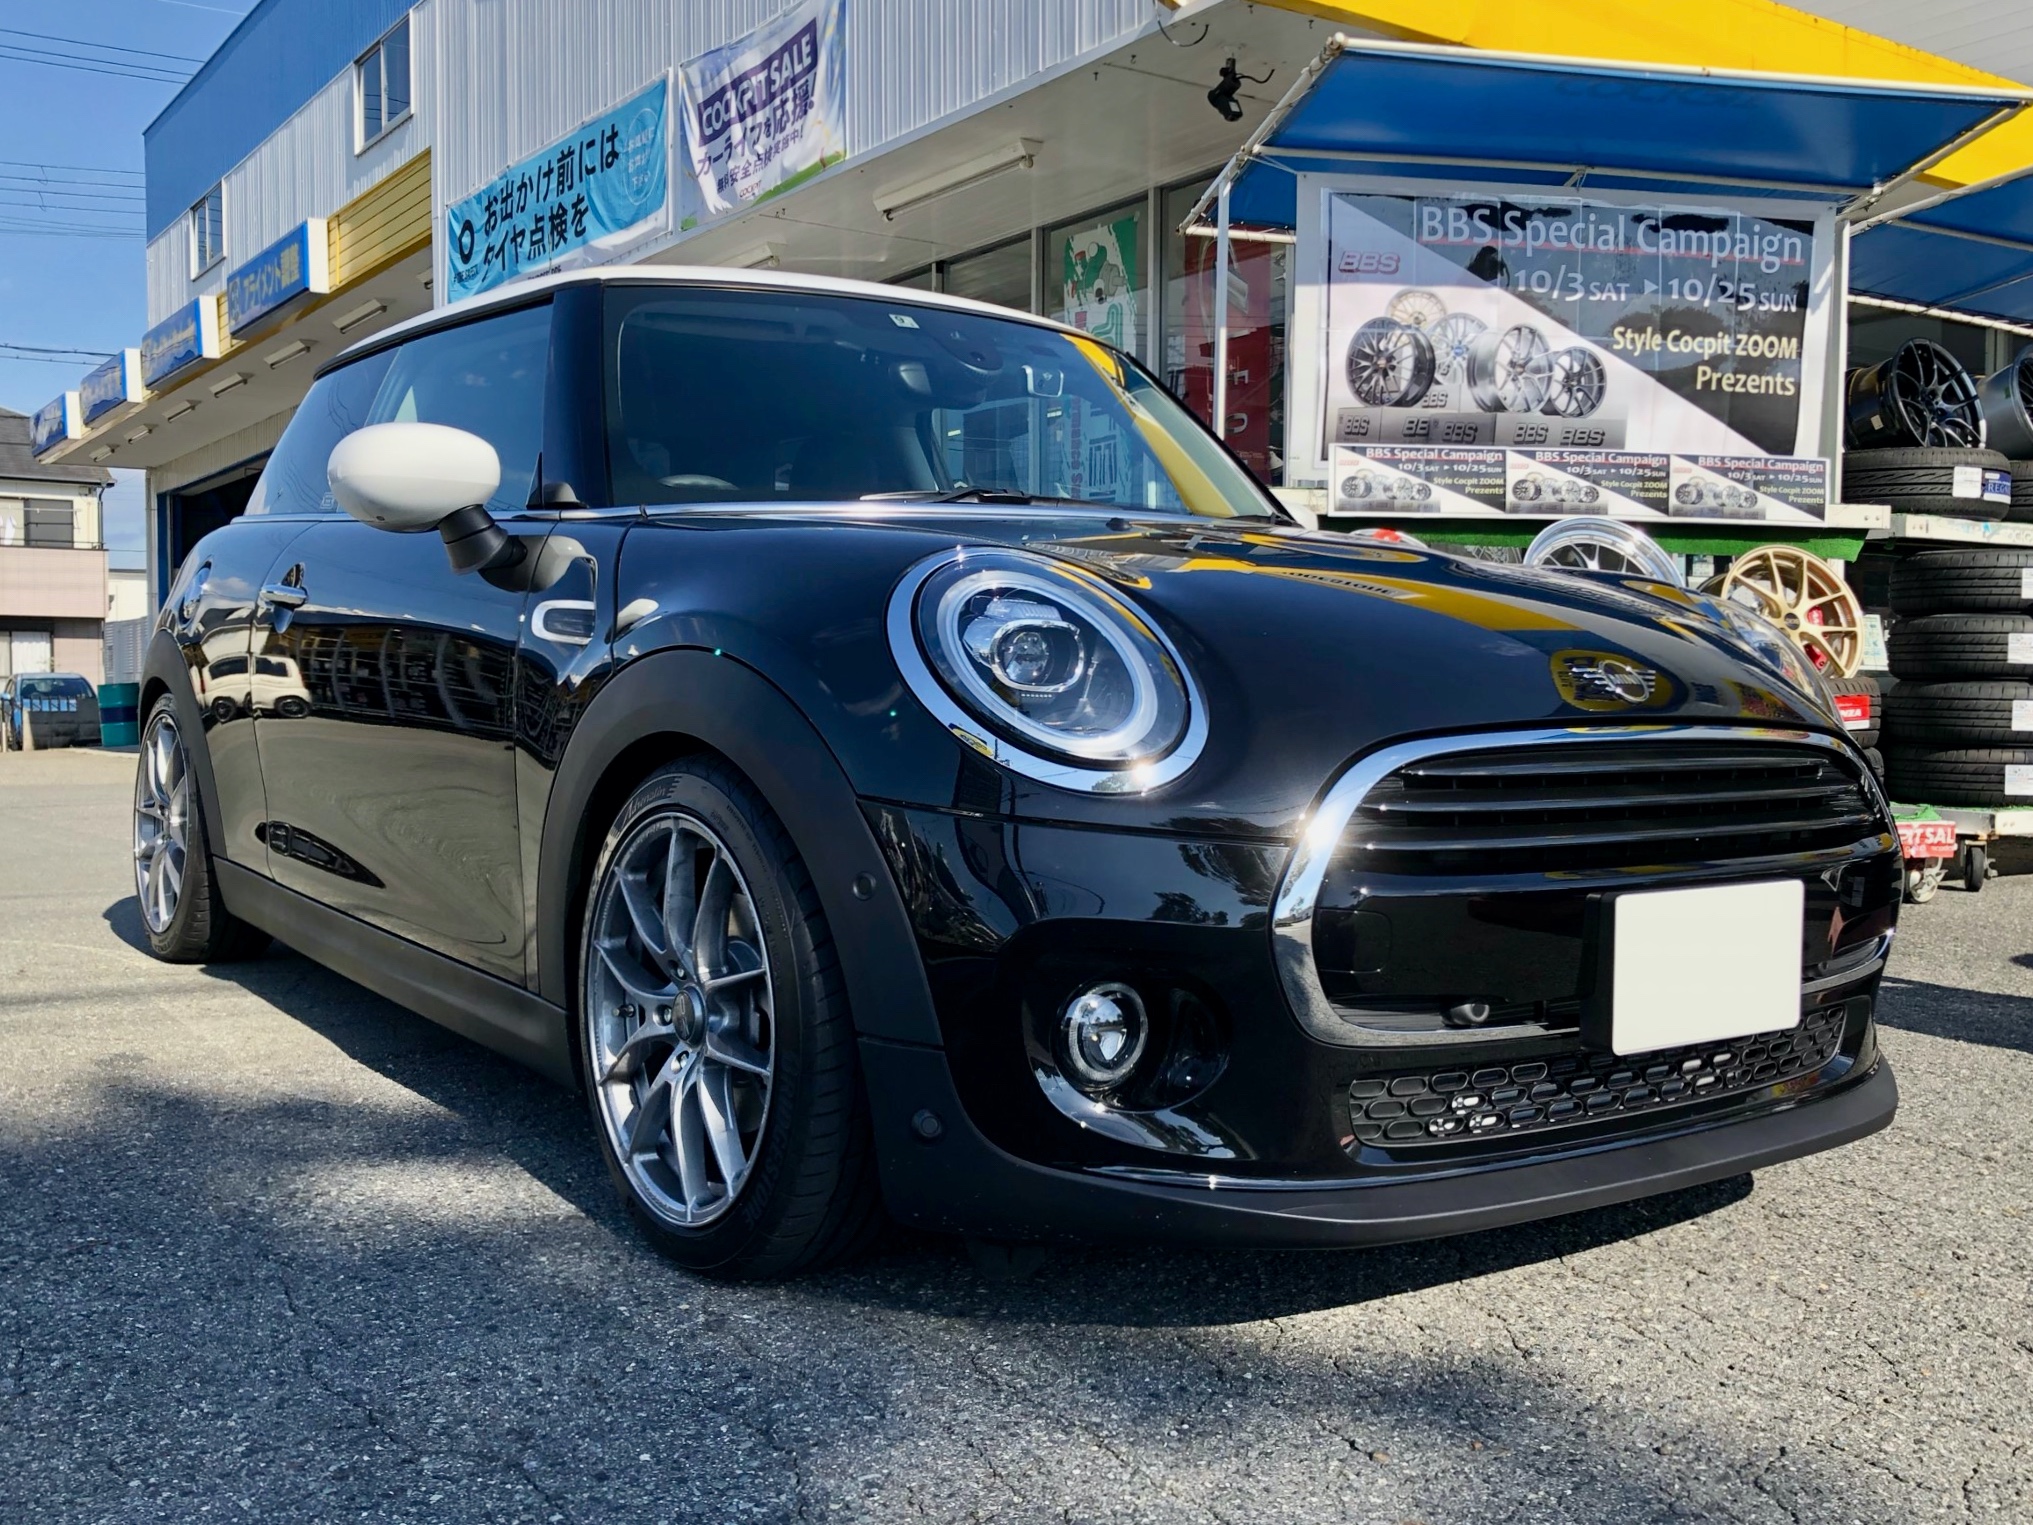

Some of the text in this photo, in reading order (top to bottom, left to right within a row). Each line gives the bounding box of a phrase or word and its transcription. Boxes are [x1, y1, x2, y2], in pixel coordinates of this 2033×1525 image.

[701, 33, 812, 136] COCKPIT SALE
[484, 123, 620, 236] お出かけ前には
[482, 193, 589, 282] タイヤ点検を
[1422, 206, 1802, 273] BBS Special Campaign
[1338, 250, 1400, 275] BBS
[1612, 326, 1798, 360] Style Cocpit ZOOM
[1696, 365, 1796, 396] Prezents
[1344, 415, 1370, 436] BBS
[1442, 422, 1478, 444] BBS
[1513, 423, 1549, 445] BBS
[1560, 427, 1606, 446] BBS
[1366, 447, 1503, 463] BBS Special Campaign
[1535, 451, 1668, 468] BBS Special Campaign
[1698, 457, 1824, 474] BBS Special Campaign
[1433, 477, 1504, 487] Style Cocpit ZOOM
[1465, 486, 1504, 495] Prezents
[1601, 480, 1619, 488] Style
[1620, 480, 1643, 489] Cocpit
[1759, 485, 1824, 495] Style Cocpit ZOOM
[1630, 489, 1668, 498] Prezents
[1788, 495, 1824, 504] Prezents
